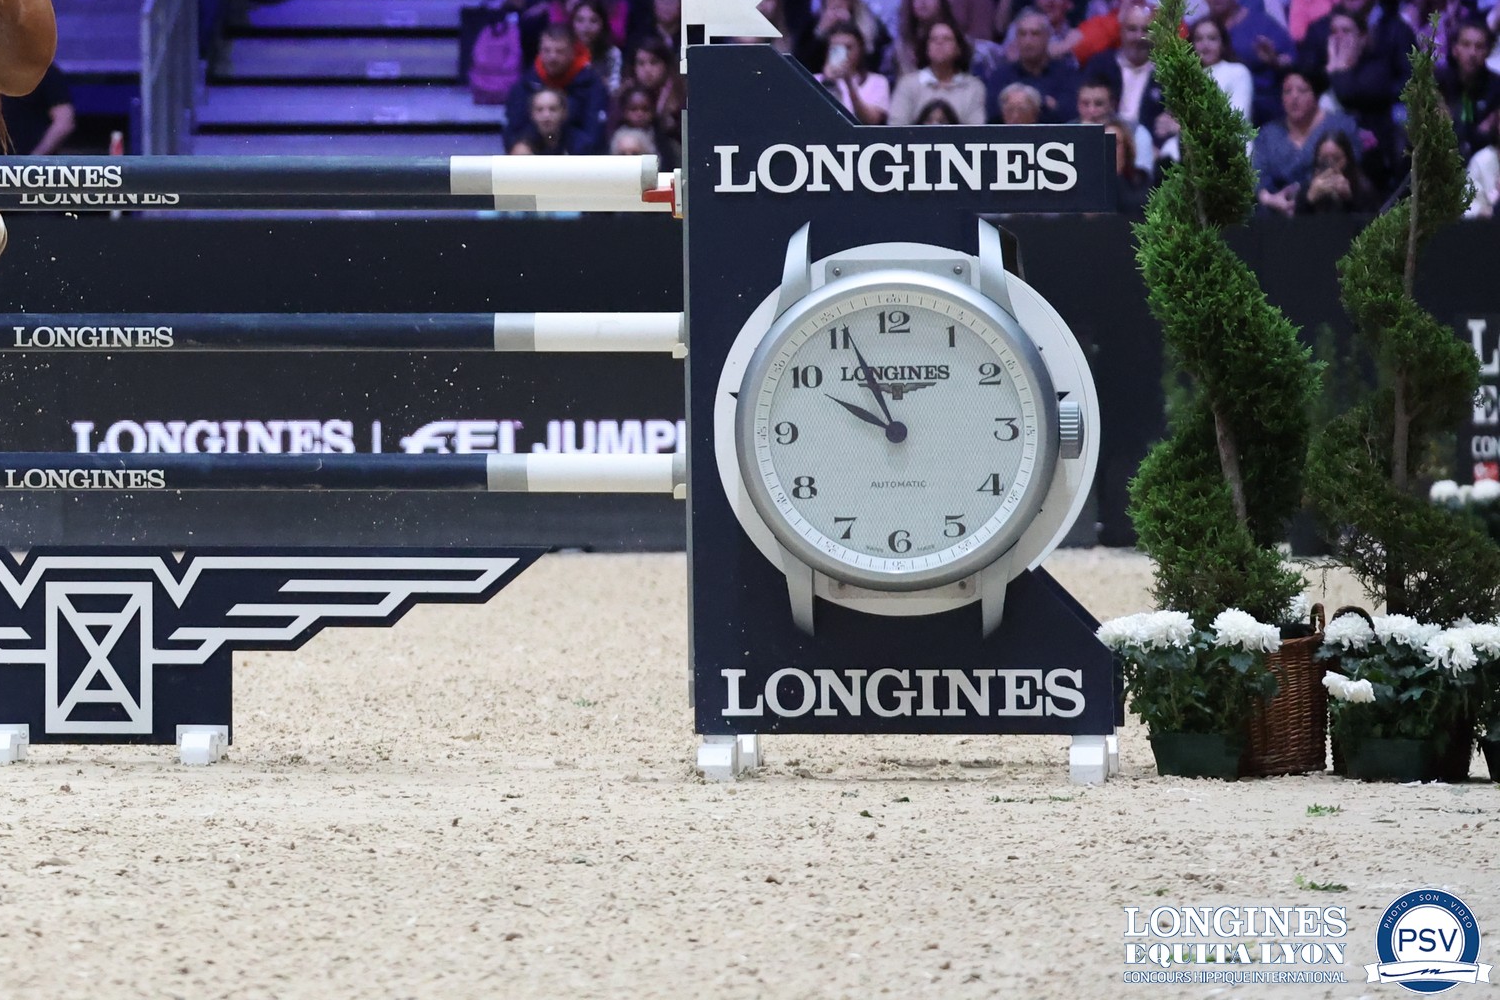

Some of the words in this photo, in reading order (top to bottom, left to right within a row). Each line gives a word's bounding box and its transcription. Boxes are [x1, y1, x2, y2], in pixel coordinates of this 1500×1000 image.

[713, 141, 1078, 194] LONGINES
[877, 310, 911, 334] 12
[12, 326, 174, 348] LONGINES
[828, 326, 851, 350] 11
[946, 325, 956, 348] 1
[791, 364, 823, 389] 10
[840, 365, 950, 381] LONGINES
[978, 362, 1002, 386] 2
[71, 420, 356, 454] LONGINES
[774, 421, 799, 445] 9
[993, 417, 1020, 442] 3
[4, 468, 166, 489] LONGINES
[792, 475, 818, 500] 8
[871, 480, 928, 489] AUTOMATIC
[976, 473, 1005, 496] 4
[833, 516, 858, 540] 7
[943, 513, 967, 538] 5
[888, 529, 912, 554] 6
[720, 667, 1086, 718] LONGINES
